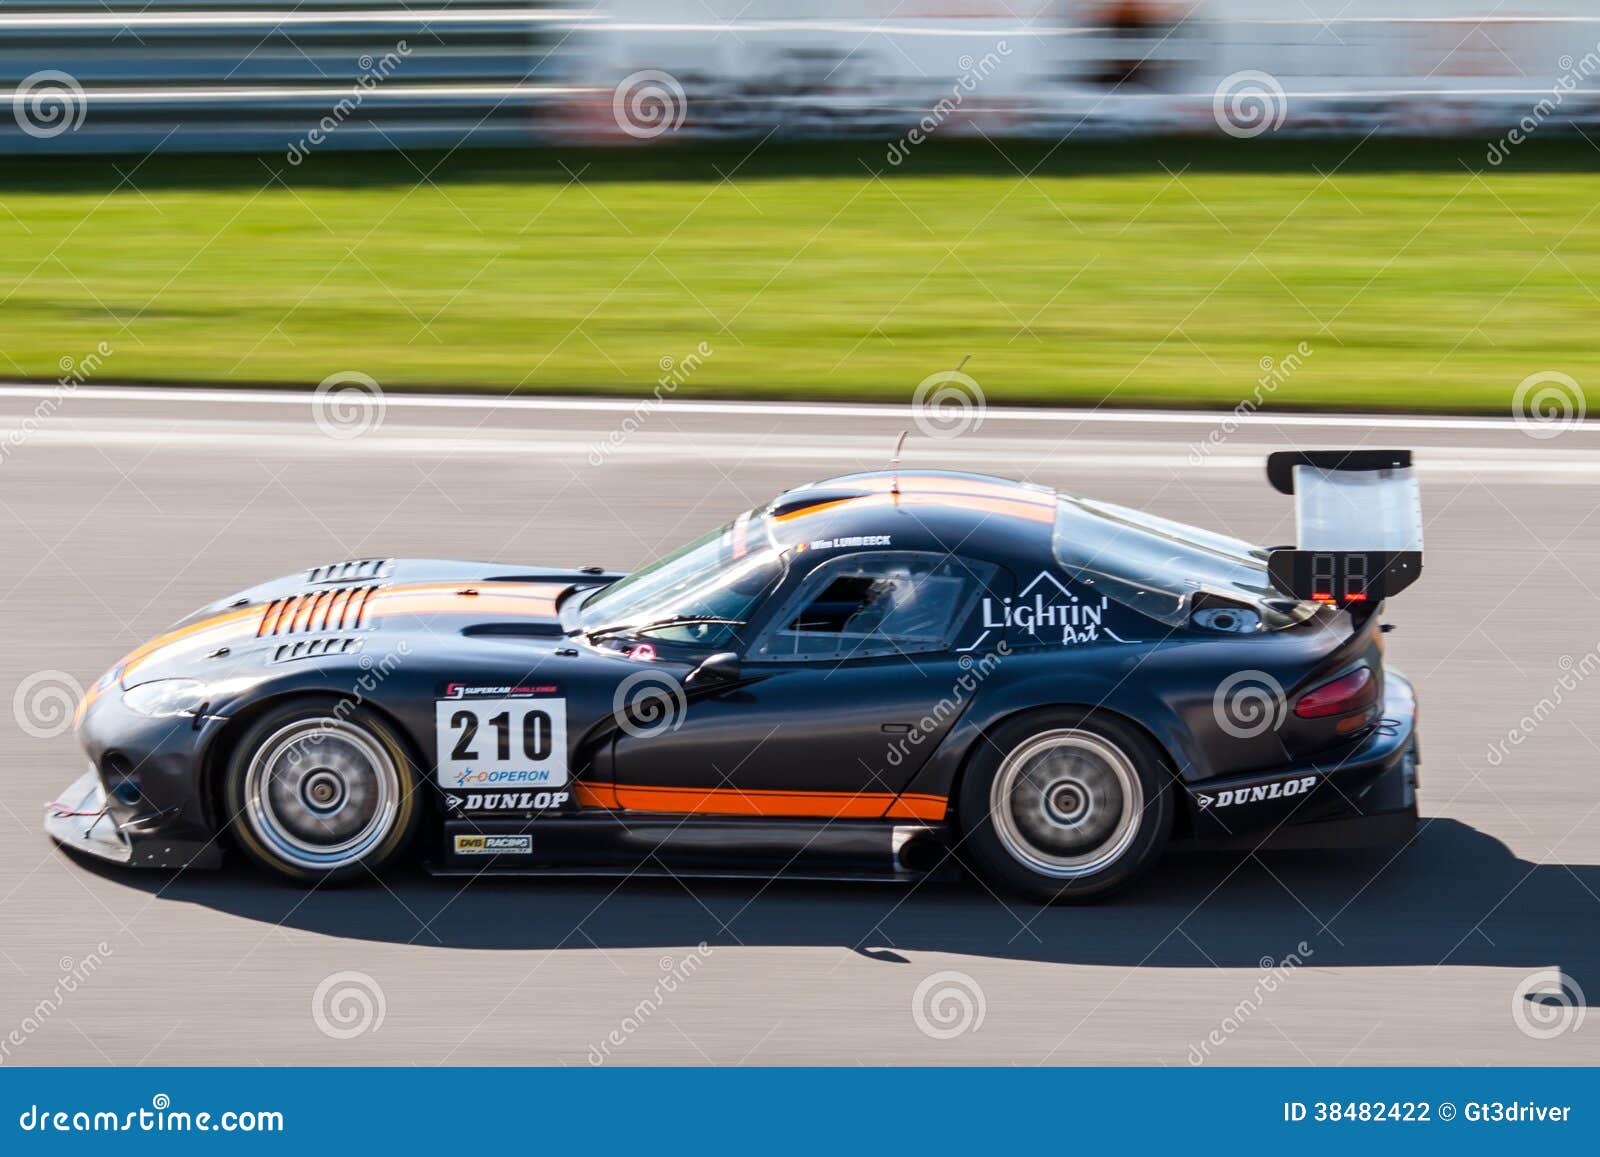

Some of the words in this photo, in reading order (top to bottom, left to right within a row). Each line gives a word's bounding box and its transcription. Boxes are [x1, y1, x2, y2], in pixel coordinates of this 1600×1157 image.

[1062, 622, 1100, 646] Art
[450, 709, 552, 762] 210
[463, 791, 570, 810] DUNLOP
[1215, 775, 1318, 808] DUNLOP
[486, 837, 529, 848] RACING
